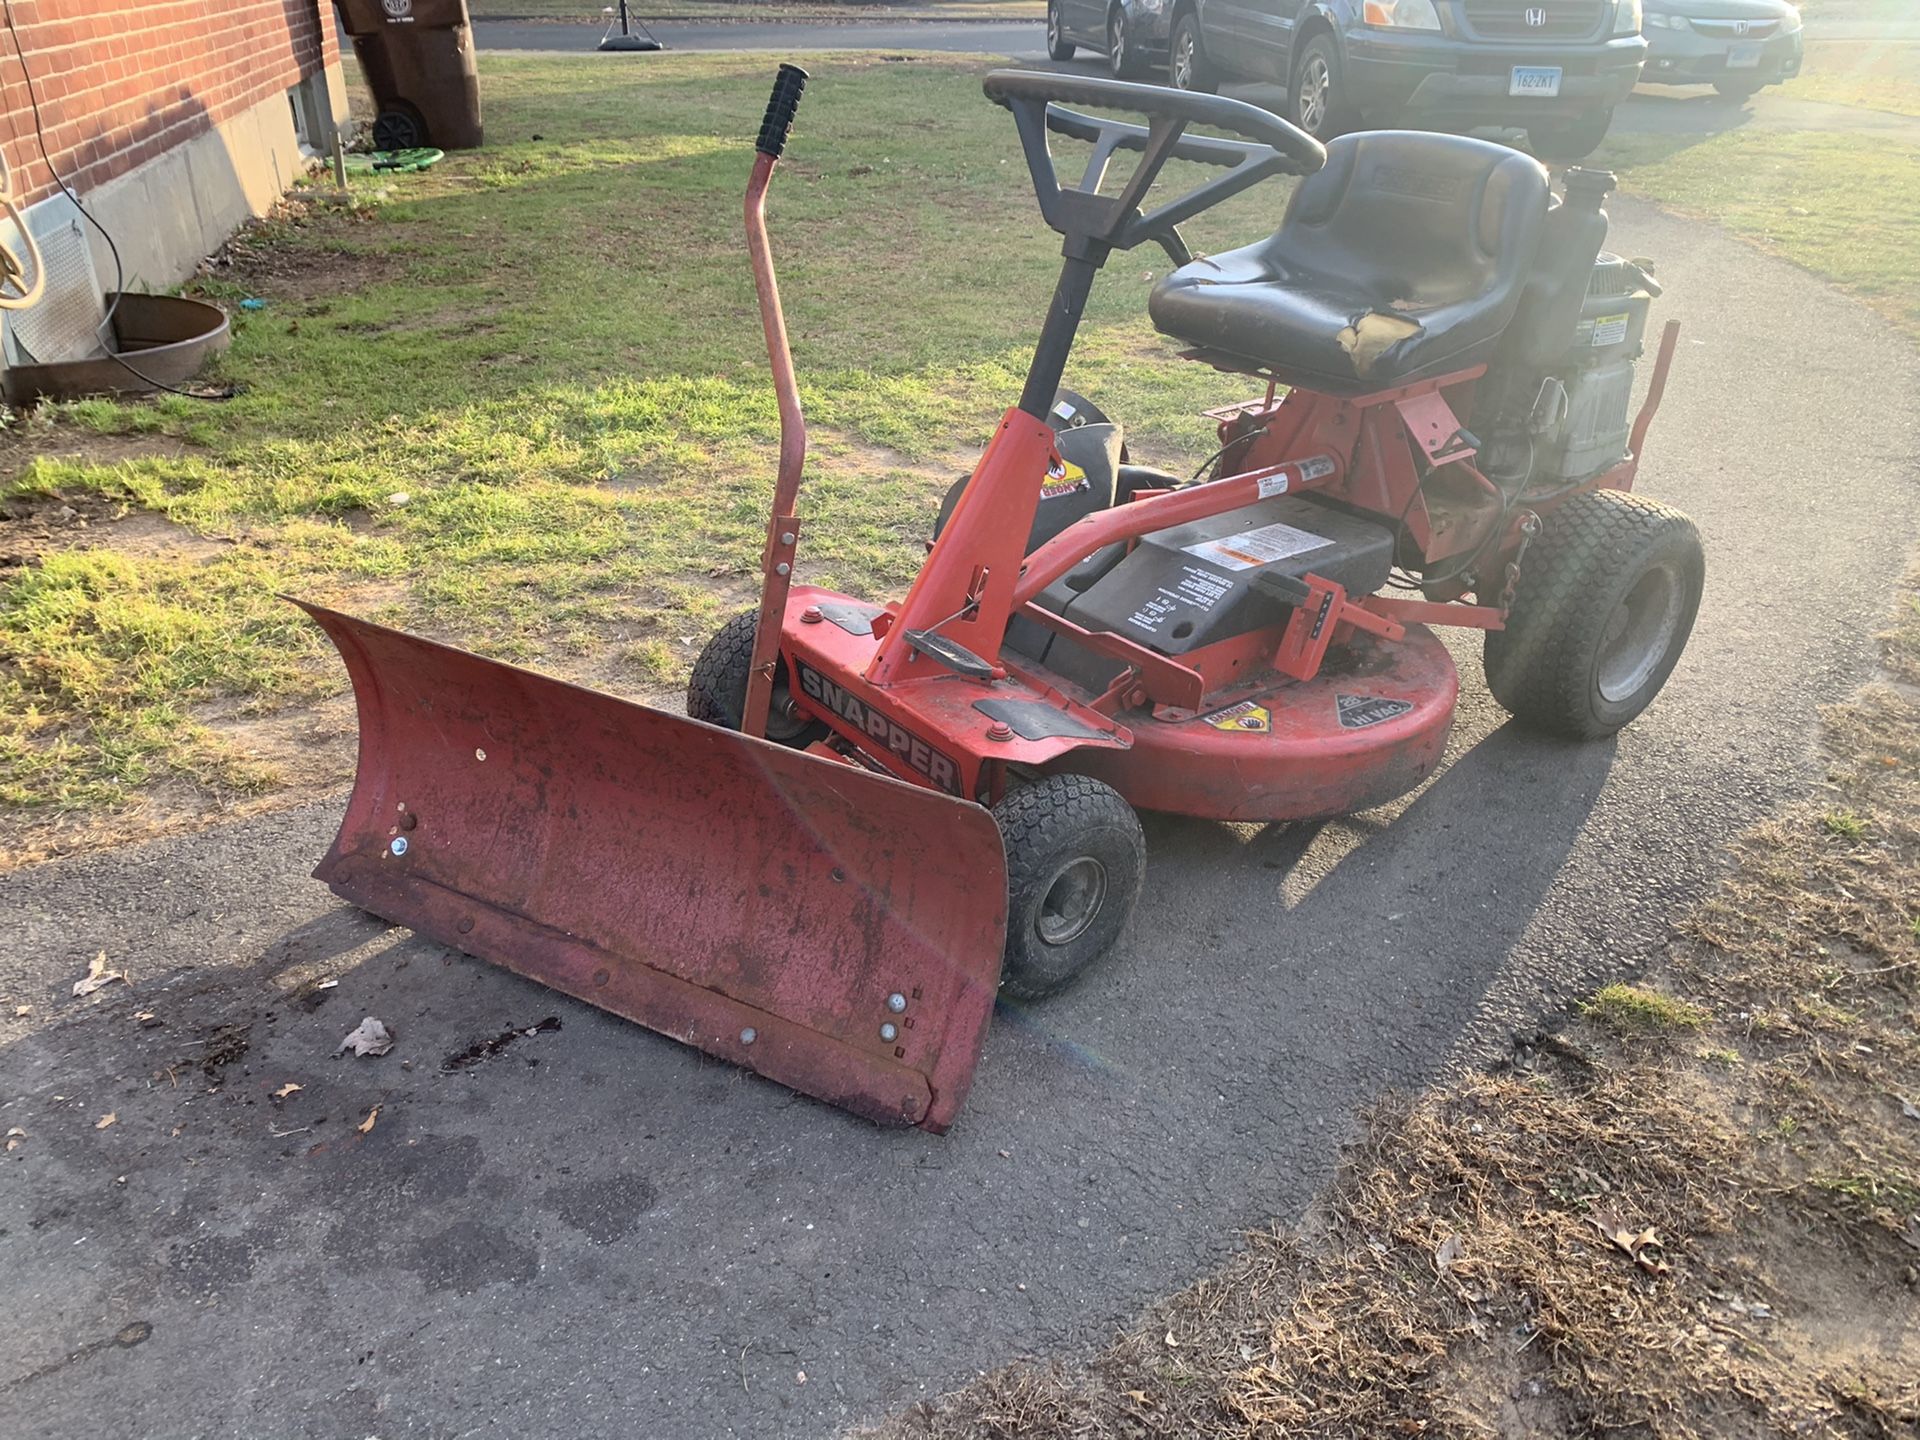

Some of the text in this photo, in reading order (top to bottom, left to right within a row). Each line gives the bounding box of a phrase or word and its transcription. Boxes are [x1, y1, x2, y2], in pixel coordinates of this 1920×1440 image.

[802, 667, 954, 790] SNAPPER
[1351, 704, 1402, 725] HI VAC
